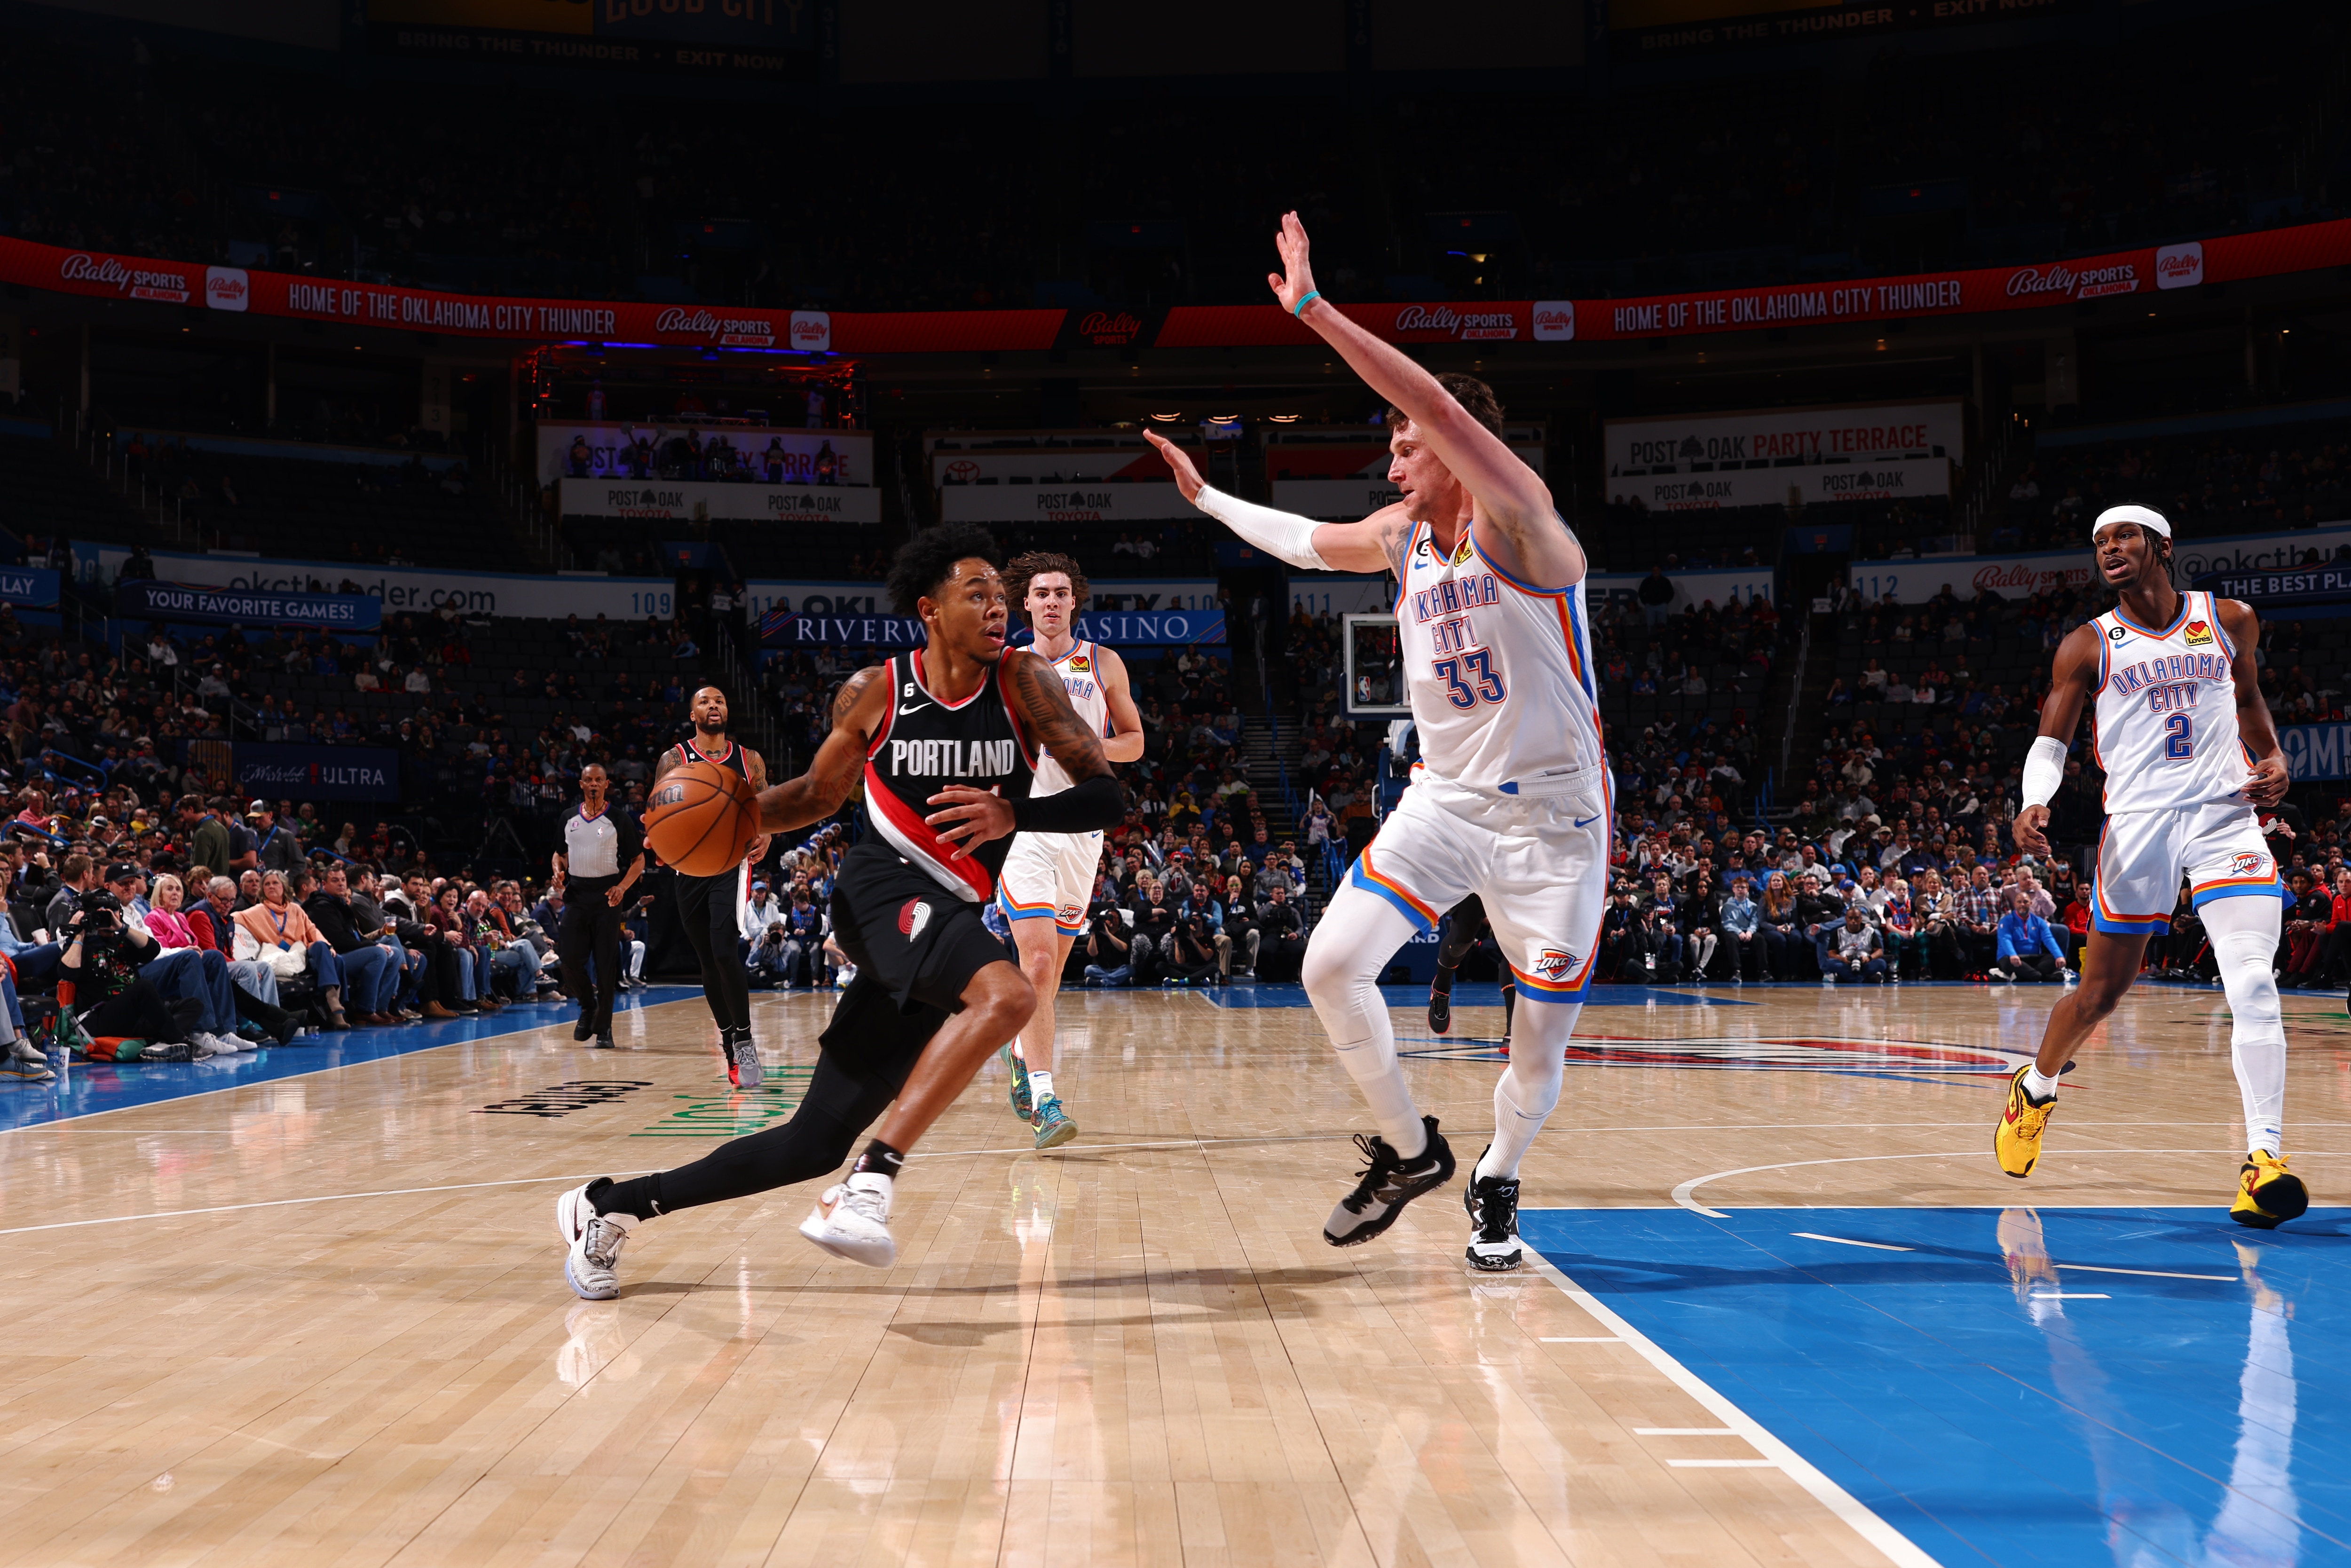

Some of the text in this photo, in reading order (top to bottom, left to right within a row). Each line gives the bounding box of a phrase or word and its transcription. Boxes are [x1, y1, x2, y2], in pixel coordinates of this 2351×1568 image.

[1641, 28, 1714, 49] BRING
[1721, 23, 1769, 40] THE
[1776, 8, 1894, 35] THUNDER
[398, 31, 785, 71] BRING THE THUNDER EXIT NOW
[61, 253, 185, 291] Bally SPORTS
[2159, 254, 2200, 274] Bally
[208, 277, 246, 297] Bally
[2006, 265, 2134, 296] Bally SPORTS
[2083, 282, 2132, 297] OKLAHOMA
[135, 287, 183, 301] OKLAHOMA
[289, 283, 615, 334] HOME OF THE OKLAHOMA CITY THUNDER
[1615, 280, 1961, 332] HOME OF THE OKLAHOMA CITY THUNDER
[656, 307, 771, 339] Bally SPORTS
[793, 321, 828, 338] Bally
[1080, 311, 1142, 339] Bally
[1396, 305, 1513, 335] Bally SPORTS
[1535, 311, 1571, 327] Bally
[725, 336, 768, 345] OKLAHOMA
[1093, 335, 1128, 346] SPORTS
[1466, 329, 1511, 339] OKLAHOMA
[1630, 425, 1928, 465] POST OAK PARTY TERRACE
[1655, 481, 1732, 500] POST OAK
[1823, 471, 1903, 491] POST OAK
[608, 490, 683, 507] POST OAK
[769, 495, 841, 512] POST OAK
[1038, 493, 1112, 509] POST OAK
[1856, 575, 1898, 598] 112
[1972, 564, 2038, 593] Bally
[2041, 568, 2089, 584] SPRTS
[2221, 578, 2263, 597] THE
[2268, 574, 2318, 594] BEST
[146, 590, 354, 620] YOUR FAVORITE GAMES!
[632, 591, 671, 614] 109
[795, 616, 1189, 643] RIVERW ASINO
[1430, 615, 1478, 655] CITY
[2112, 629, 2122, 640] 6
[2188, 634, 2210, 645] Love's
[1432, 647, 1508, 710] 33
[2110, 653, 2227, 696] OKLAHOMA
[904, 682, 915, 698] 6
[2148, 683, 2198, 712] CITY
[2165, 713, 2193, 760] 2
[890, 739, 1015, 777] PORTLAND
[323, 766, 385, 786] ULTRA
[2233, 856, 2258, 872] OKC
[1537, 957, 1569, 970] OKC
